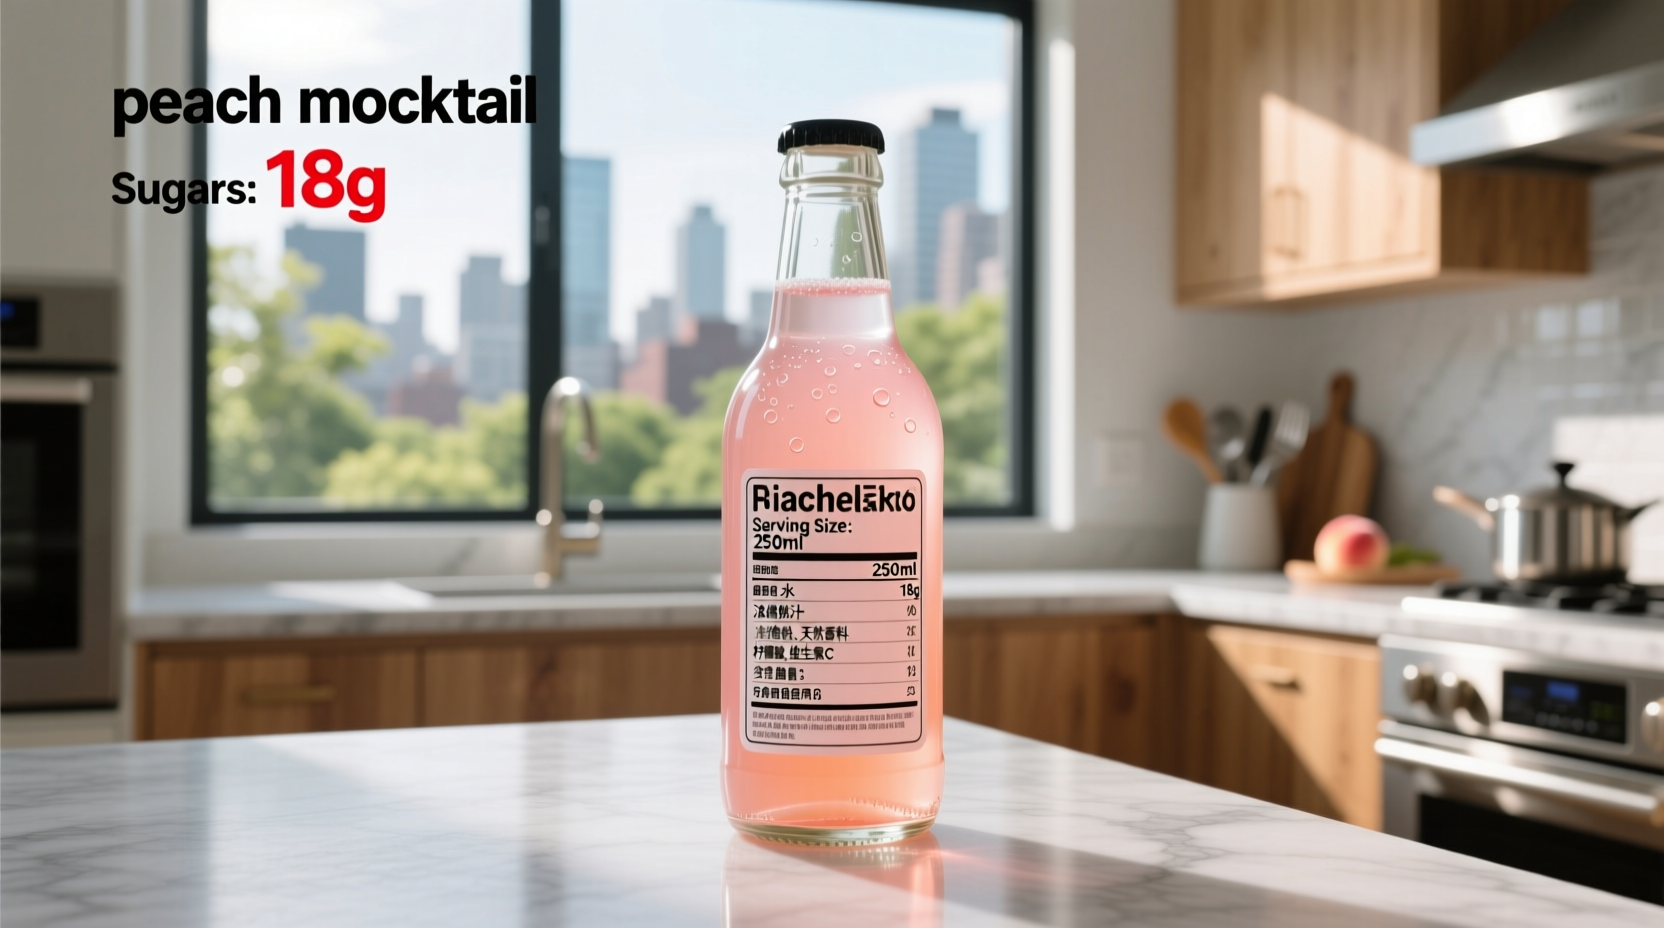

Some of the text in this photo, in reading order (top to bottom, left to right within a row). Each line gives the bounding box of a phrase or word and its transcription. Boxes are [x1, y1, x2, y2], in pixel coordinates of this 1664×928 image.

[753, 517, 852, 537] Serving Size:
[753, 534, 803, 550] 250ml
[872, 562, 917, 577] 250ml
[900, 583, 920, 600] 18g
